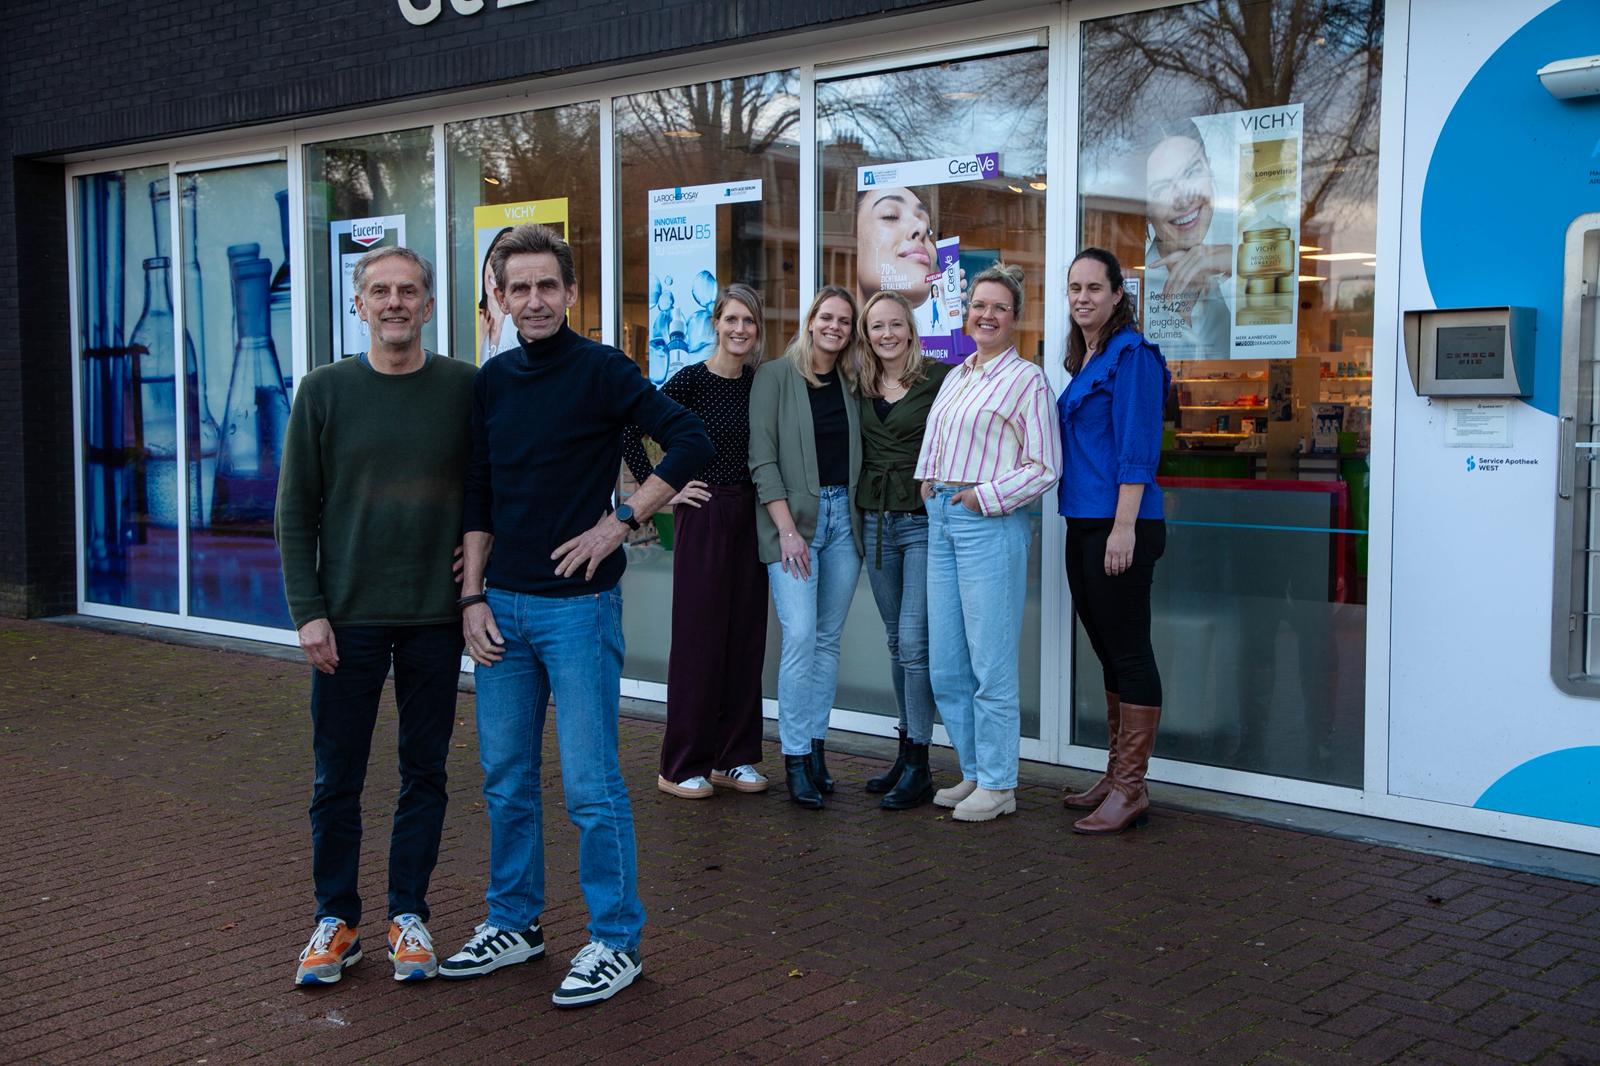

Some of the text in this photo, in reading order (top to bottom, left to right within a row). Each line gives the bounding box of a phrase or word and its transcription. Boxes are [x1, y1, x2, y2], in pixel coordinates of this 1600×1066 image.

[1241, 110, 1299, 131] VICHY
[948, 156, 995, 175] CeraVe
[504, 205, 537, 219] VICHY
[654, 216, 687, 226] INNOVATIE
[352, 222, 383, 238] Eucerin
[654, 224, 711, 243] HYALU B5
[1255, 244, 1278, 253] VICHY
[945, 255, 956, 293] CeraVe
[1149, 301, 1191, 314] tot +42%
[1149, 317, 1185, 328] jeugdige
[1149, 329, 1183, 339] volumes
[920, 349, 949, 359] RAMIDEN
[1504, 458, 1539, 466] Apotheek
